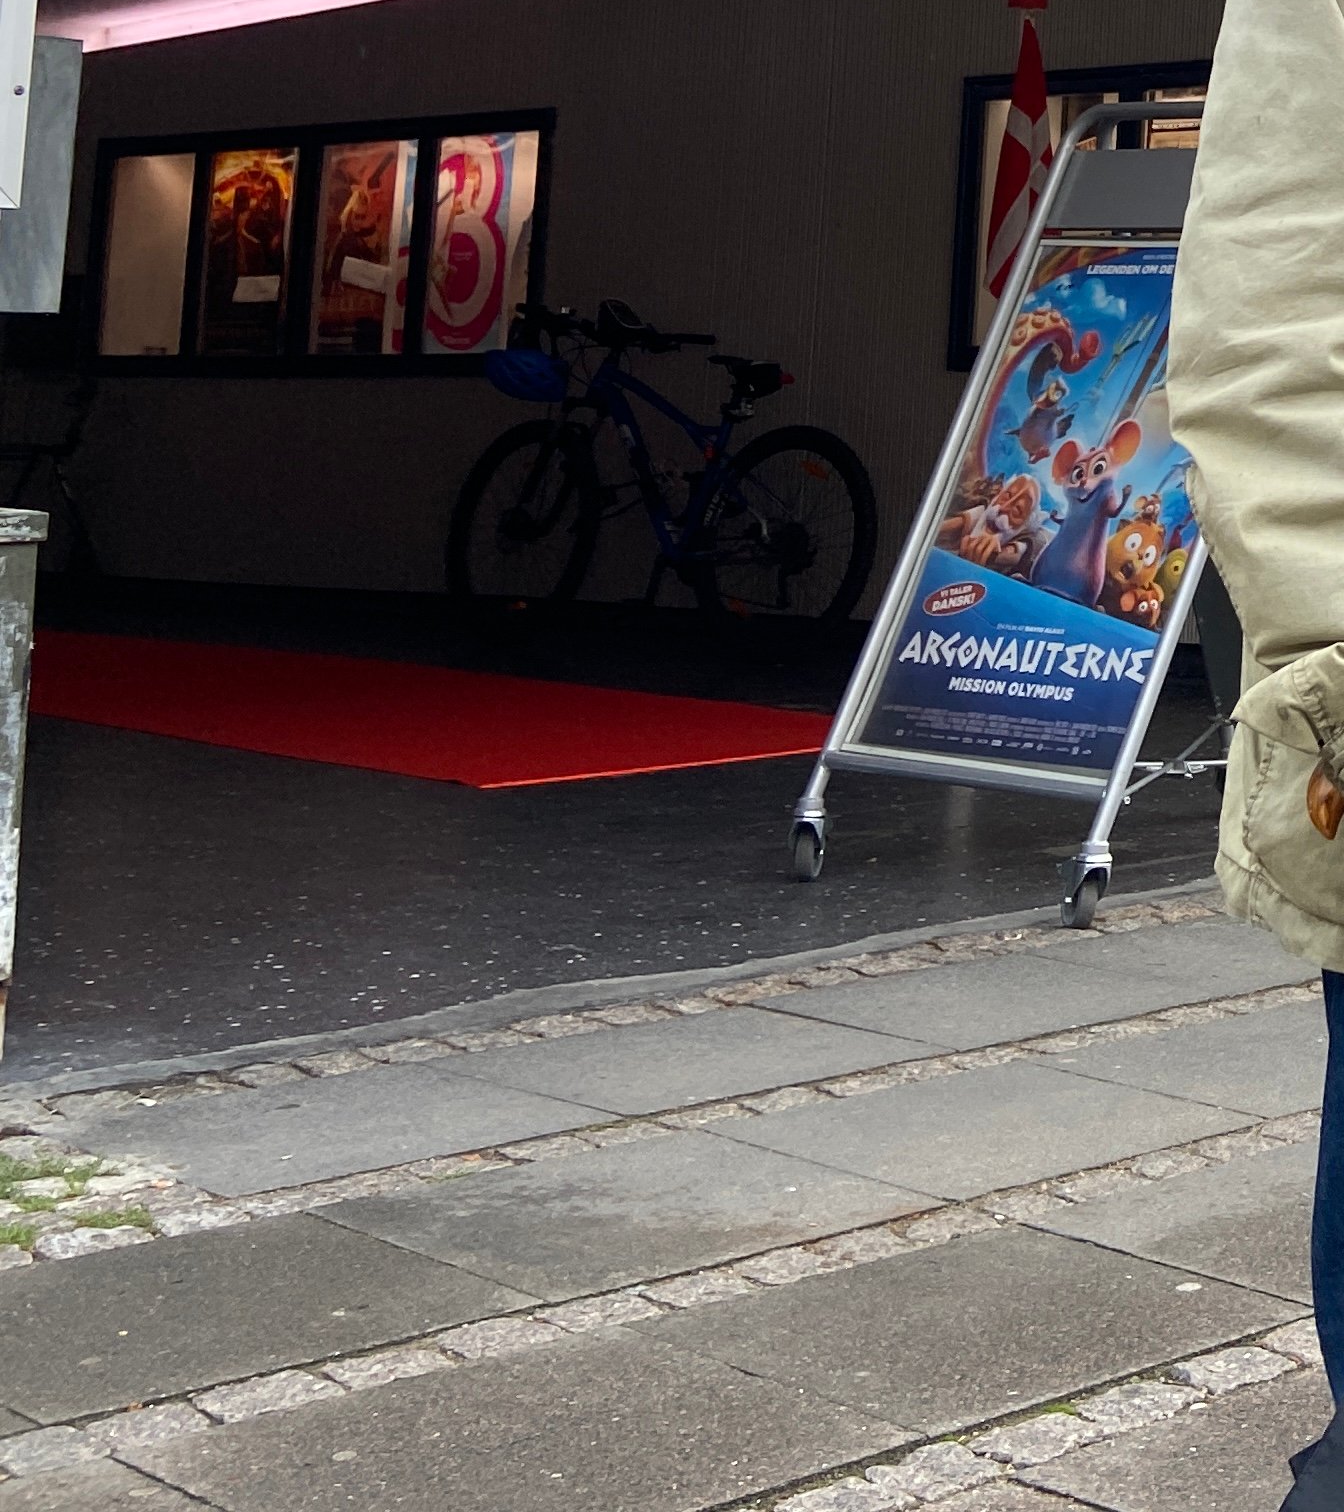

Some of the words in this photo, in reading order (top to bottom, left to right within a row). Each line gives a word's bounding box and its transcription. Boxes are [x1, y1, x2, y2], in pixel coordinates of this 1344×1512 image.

[931, 592, 977, 612] DANSK!
[898, 629, 1155, 685] ARGONAUTERNE
[948, 676, 1005, 696] MISSION
[1007, 681, 1075, 702] OLYMPUS
